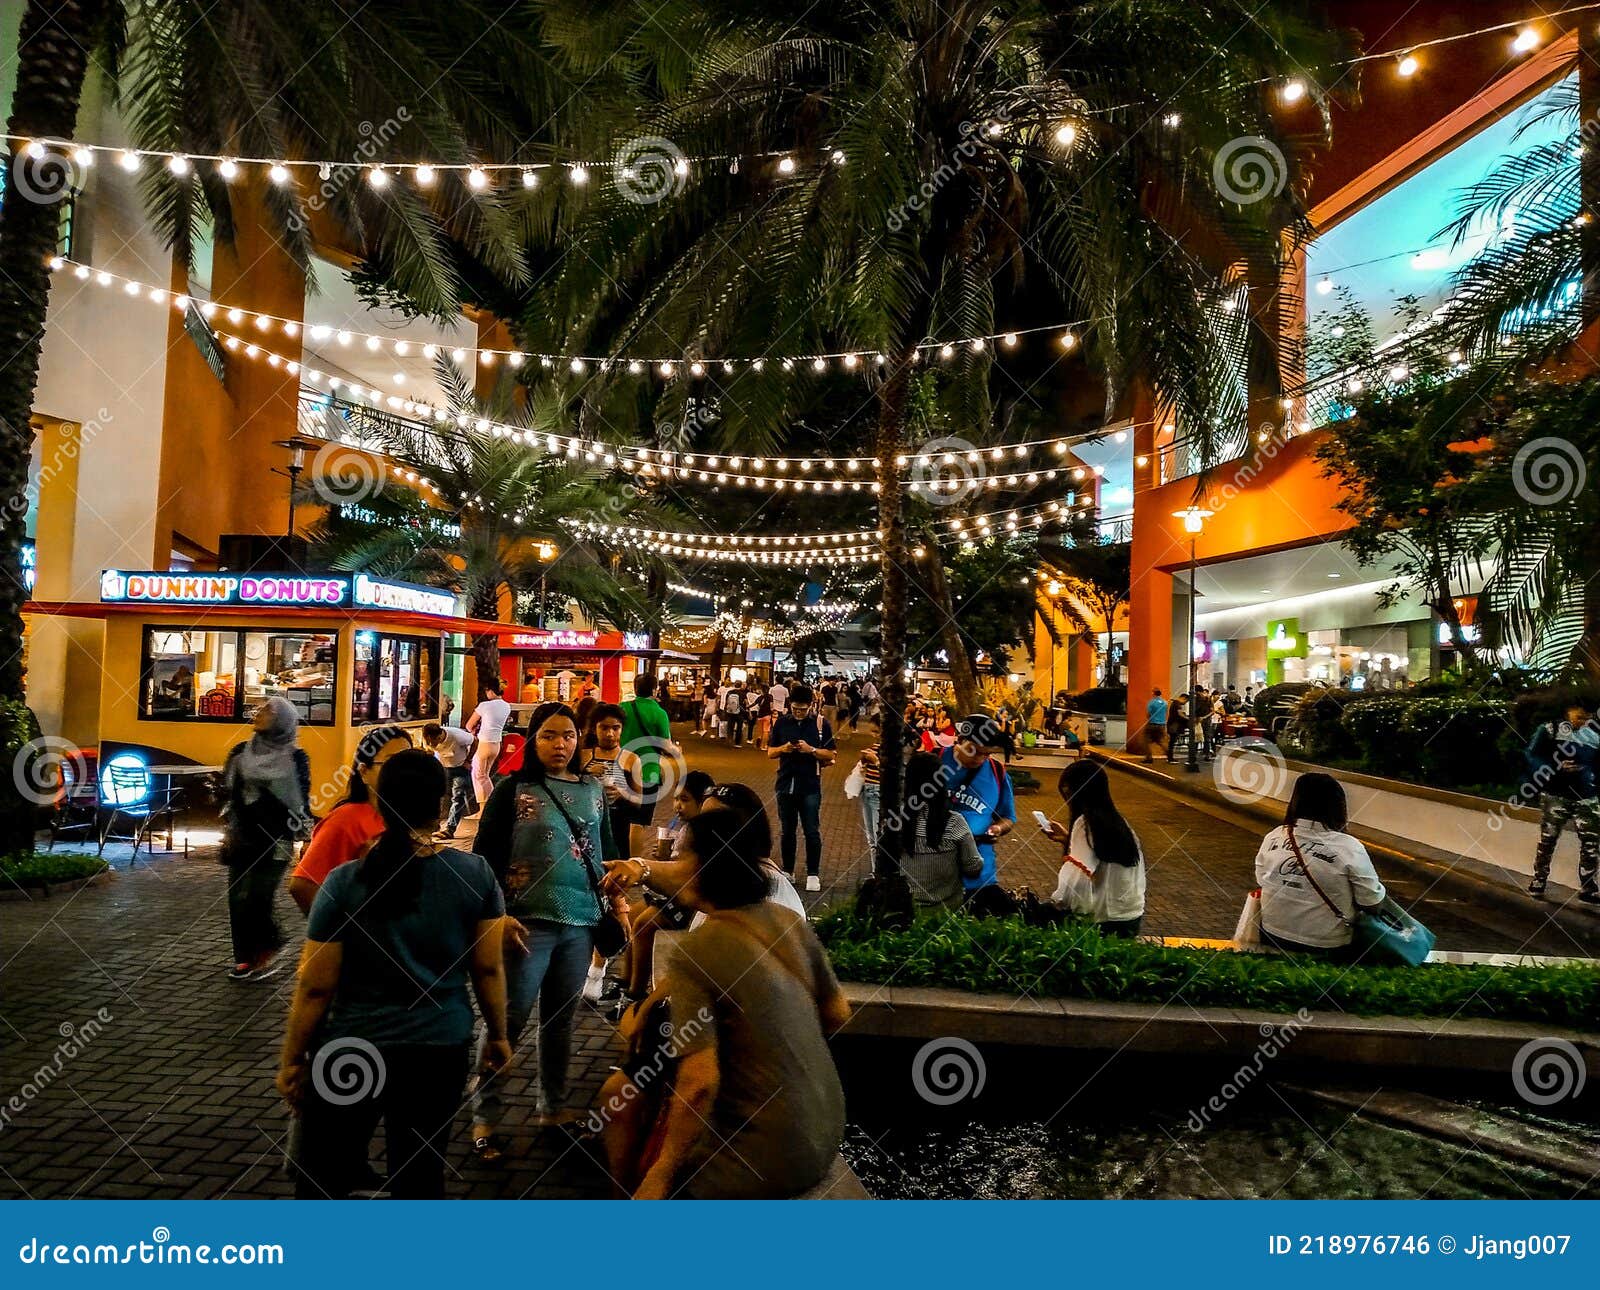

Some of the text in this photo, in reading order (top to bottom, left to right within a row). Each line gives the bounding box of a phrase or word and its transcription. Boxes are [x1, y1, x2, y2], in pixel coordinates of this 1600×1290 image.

[128, 577, 341, 601] DUNKIN' DONUTS
[960, 793, 988, 814] YORK
